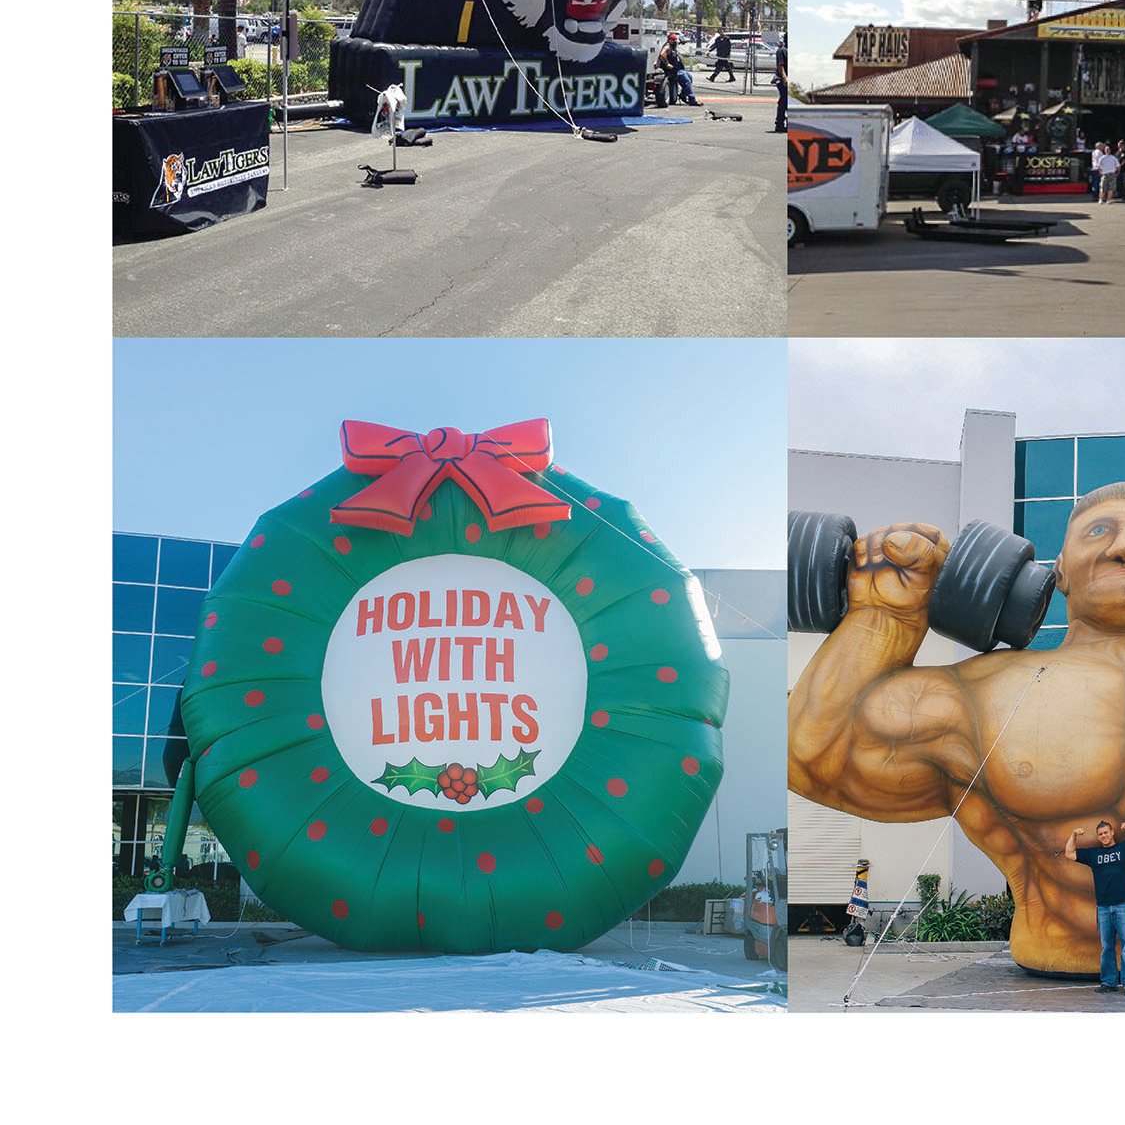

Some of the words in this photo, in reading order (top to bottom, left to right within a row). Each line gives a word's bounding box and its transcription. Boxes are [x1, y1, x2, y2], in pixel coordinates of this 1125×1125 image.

[856, 32, 876, 57] TAP
[878, 32, 908, 58] HAUS
[356, 589, 551, 636] HOLIDAY
[392, 637, 514, 683] WITH
[371, 693, 539, 745] LIGHTS
[1097, 851, 1121, 864] OBEY
